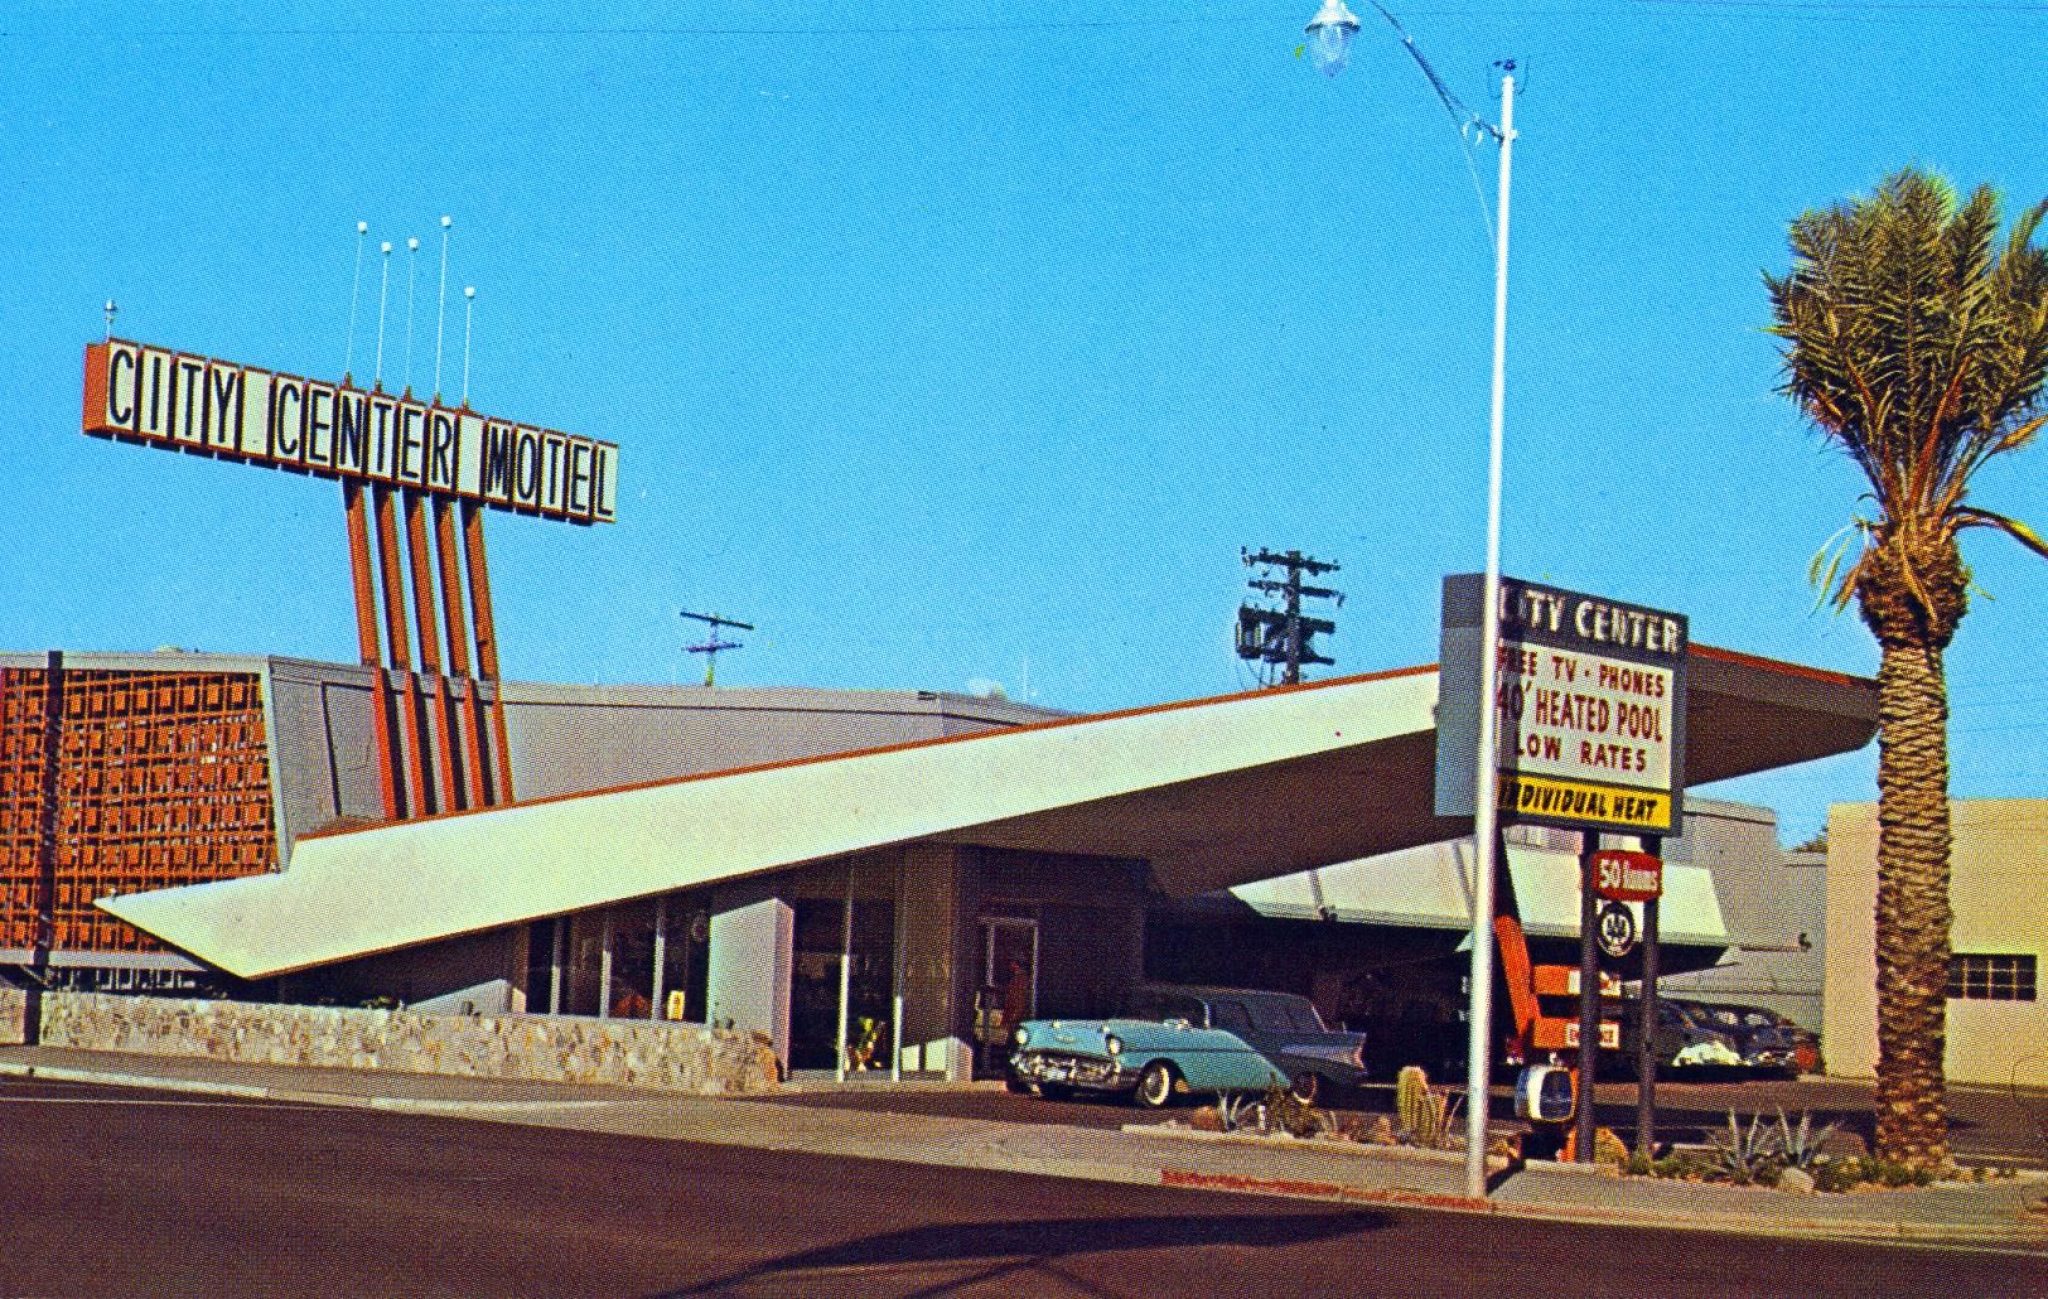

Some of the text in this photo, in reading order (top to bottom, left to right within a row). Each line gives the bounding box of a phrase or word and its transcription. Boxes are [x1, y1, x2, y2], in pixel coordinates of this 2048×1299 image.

[109, 348, 615, 517] CITY CENTER MOTEL
[1574, 599, 1681, 654] CENTER
[1552, 655, 1577, 682] TV
[1598, 663, 1665, 699] PHONES
[1535, 687, 1610, 734] HEATED
[1616, 701, 1664, 743] POOL
[1515, 732, 1648, 774] LOW RATES
[1612, 796, 1658, 822] HEAT
[1599, 858, 1620, 889] 50
